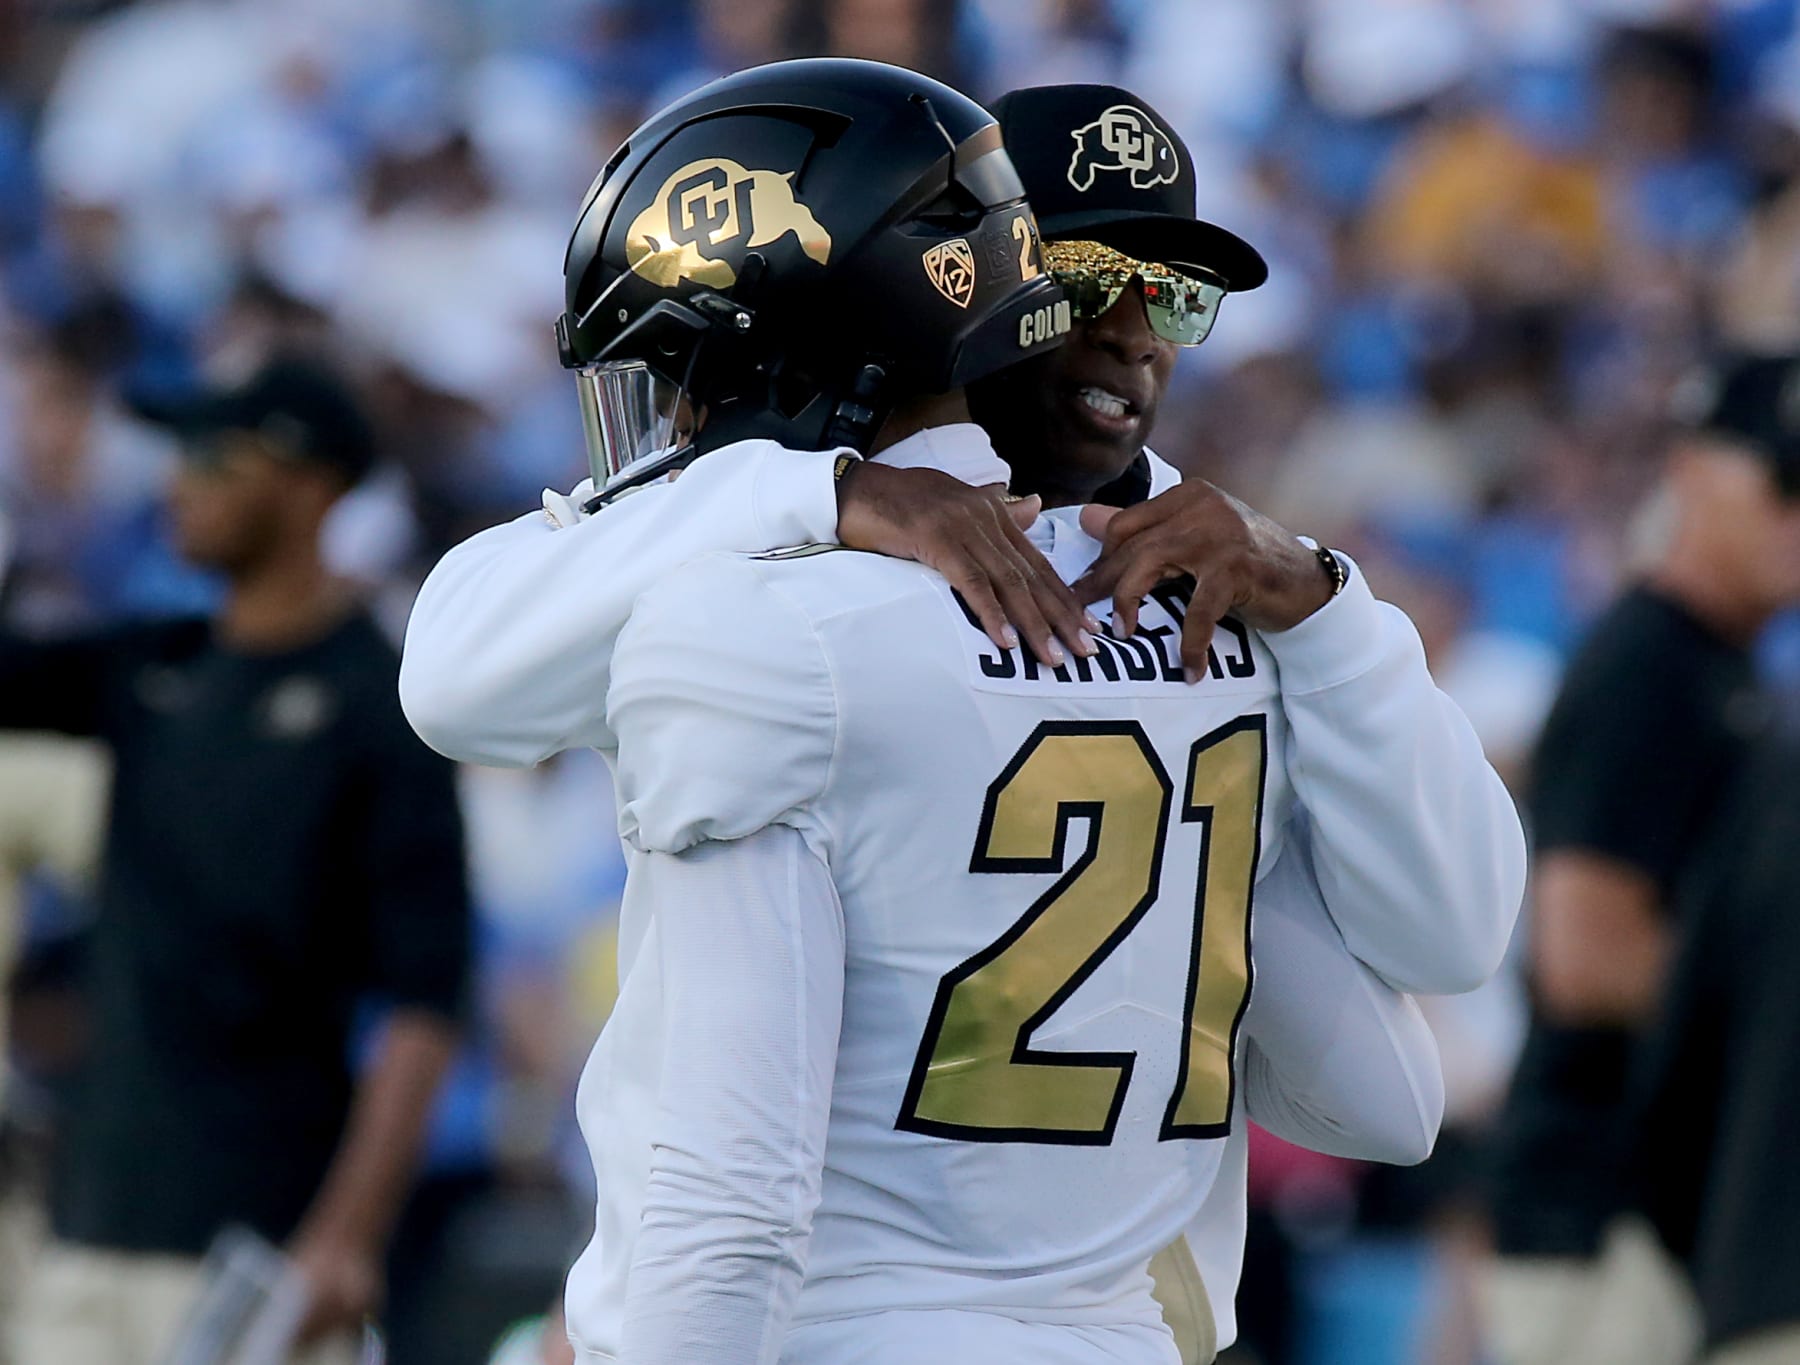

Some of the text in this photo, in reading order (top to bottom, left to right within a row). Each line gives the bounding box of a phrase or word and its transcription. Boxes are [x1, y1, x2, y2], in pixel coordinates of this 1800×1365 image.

[1101, 114, 1154, 171] CU
[667, 166, 755, 261] CU
[925, 243, 972, 287] PAC
[943, 268, 970, 296] 12
[894, 713, 1267, 1146] 21
